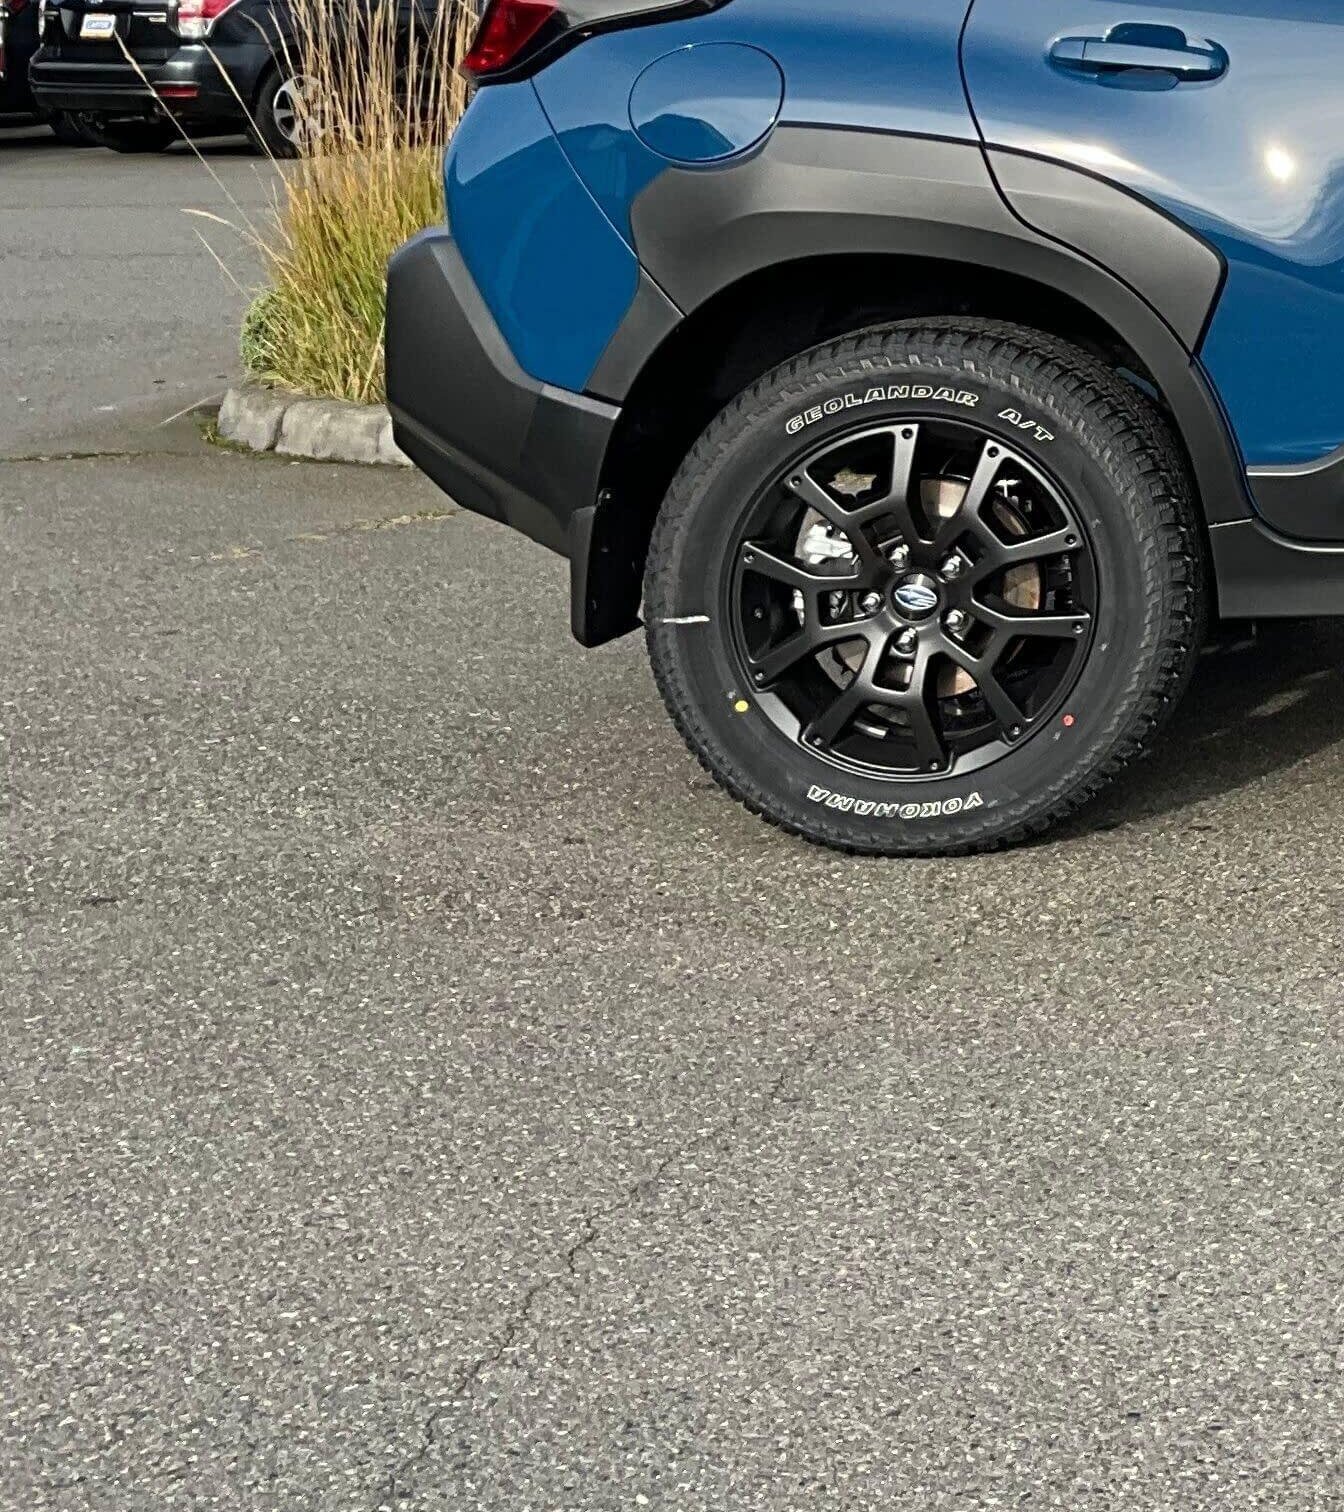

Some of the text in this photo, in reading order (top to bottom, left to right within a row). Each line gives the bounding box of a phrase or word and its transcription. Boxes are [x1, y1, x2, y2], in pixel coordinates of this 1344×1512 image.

[786, 384, 1055, 442] GEOLANDAR A/T
[807, 784, 984, 820] YOKOHAMA
